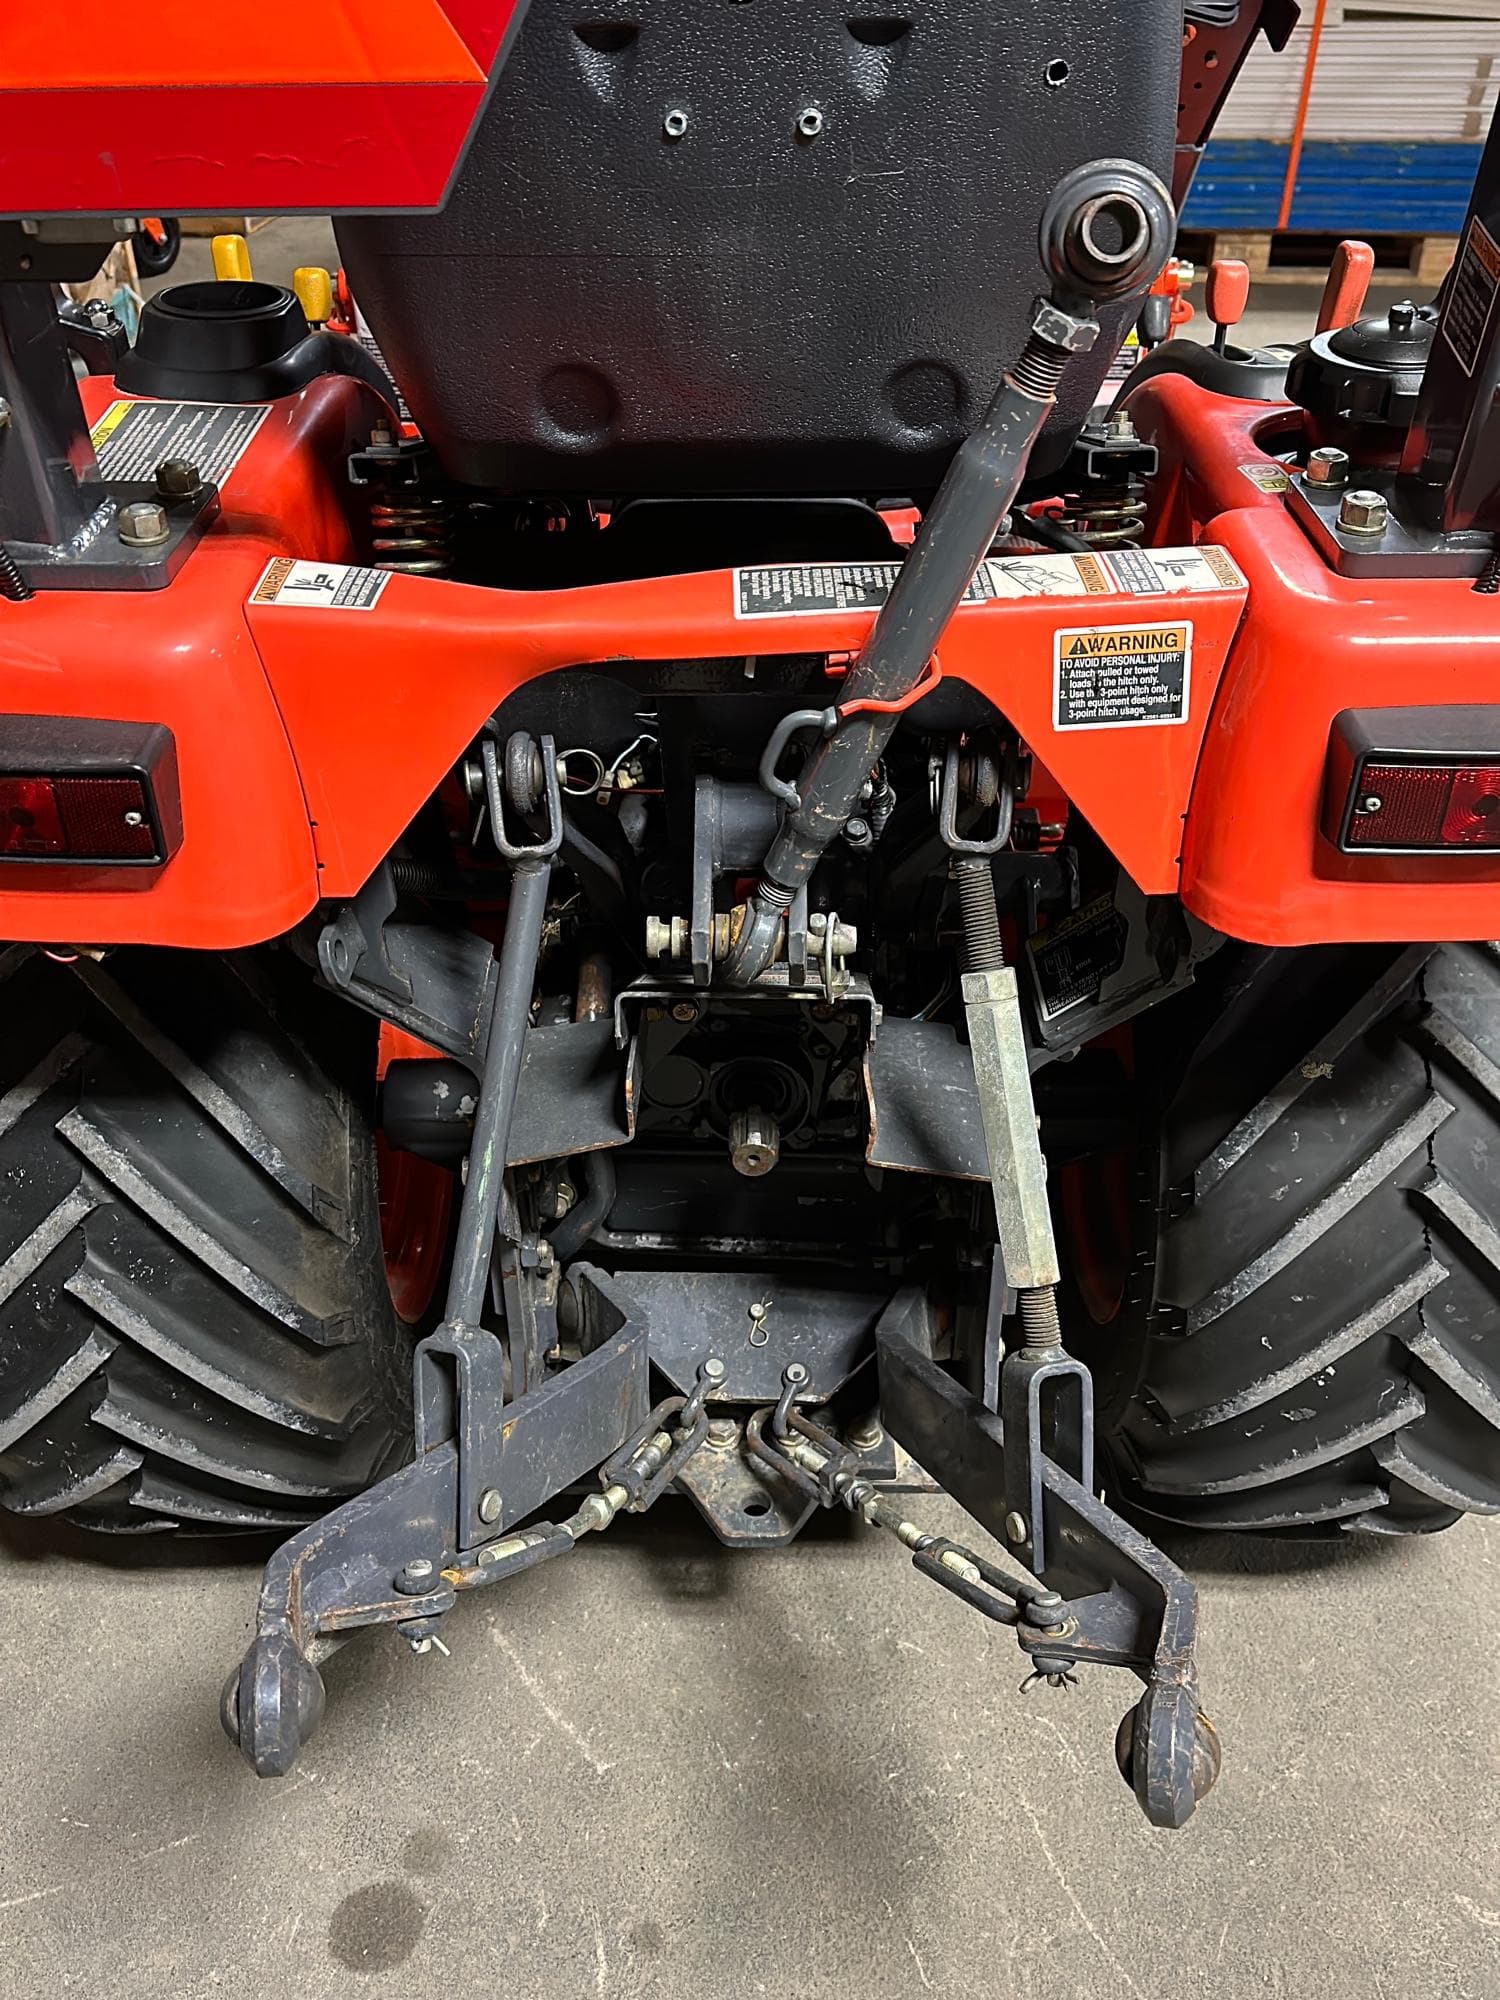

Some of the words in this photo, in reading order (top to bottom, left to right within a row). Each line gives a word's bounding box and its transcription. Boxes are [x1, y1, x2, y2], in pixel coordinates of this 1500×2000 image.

[1079, 556, 1104, 592] WARNING
[1088, 632, 1179, 653] WARNING
[1060, 659, 1073, 669] TO
[1074, 657, 1099, 668] AVOID
[1101, 655, 1147, 667] PERSONAL
[1148, 652, 1180, 664] INJURY:
[1061, 670, 1068, 679] 1.
[1069, 668, 1096, 679] Attach
[1123, 667, 1133, 675] or
[1134, 664, 1159, 675] towed
[1069, 679, 1092, 689] loads
[1103, 677, 1117, 687] the
[1118, 675, 1139, 685] hitch
[1139, 674, 1159, 685] only.
[1069, 689, 1085, 698] Use
[1100, 685, 1128, 698] 3-point
[1129, 684, 1150, 696] hitch
[1151, 683, 1169, 694] only
[1068, 698, 1086, 708] with
[1087, 696, 1130, 709] equipment
[1130, 693, 1168, 706] designed
[1169, 692, 1182, 703] for
[1068, 708, 1097, 720] 3-point
[1098, 706, 1119, 717] hitch
[1120, 705, 1147, 717] usage.
